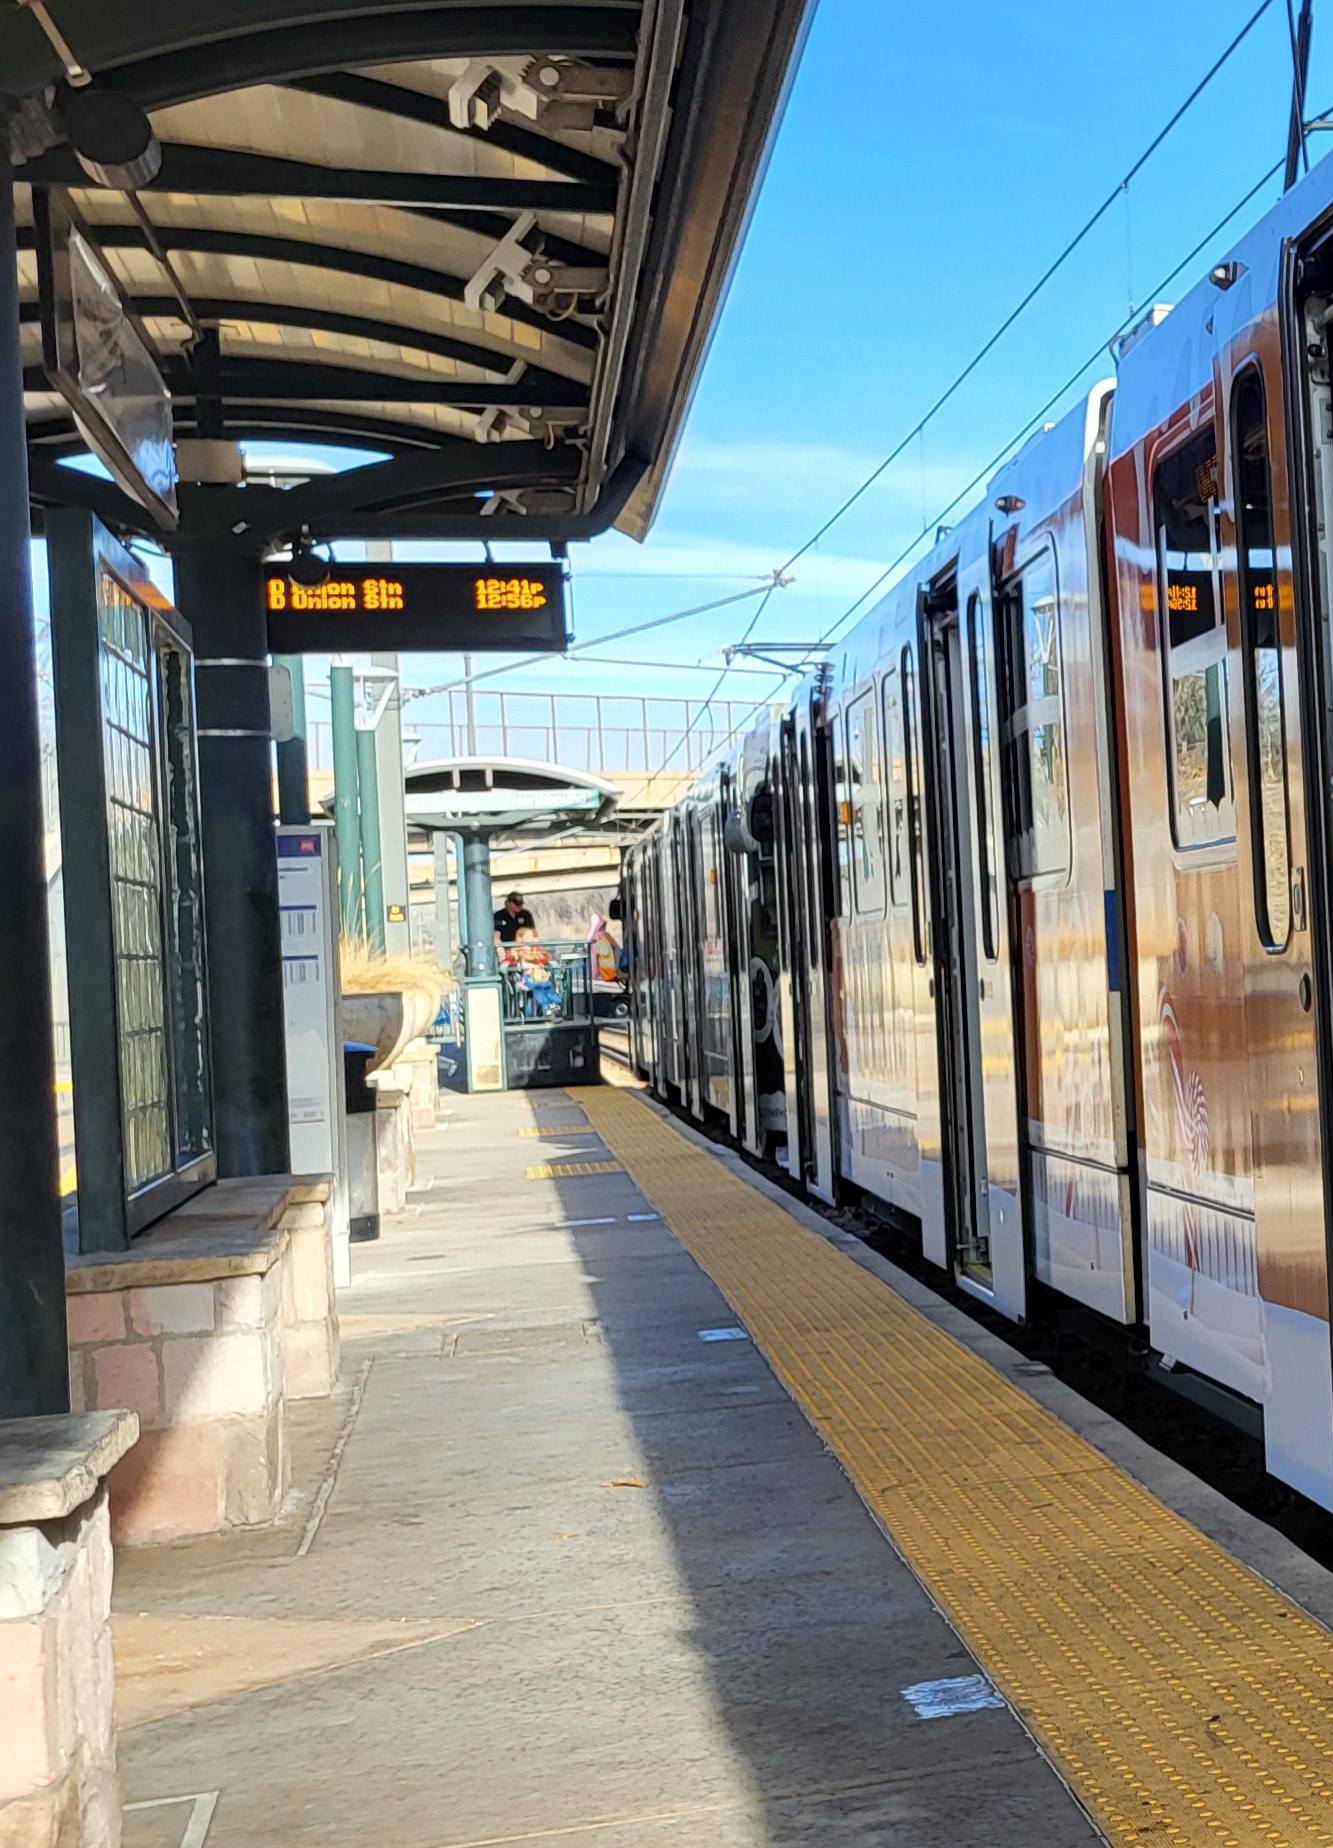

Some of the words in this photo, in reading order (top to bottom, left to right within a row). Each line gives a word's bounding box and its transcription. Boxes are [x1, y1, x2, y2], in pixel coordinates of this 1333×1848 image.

[268, 579, 285, 594] D
[363, 579, 403, 595] Stn
[268, 594, 286, 609] D
[292, 593, 356, 609] Union
[363, 594, 403, 609] Stn
[511, 791, 587, 806] Northbound
